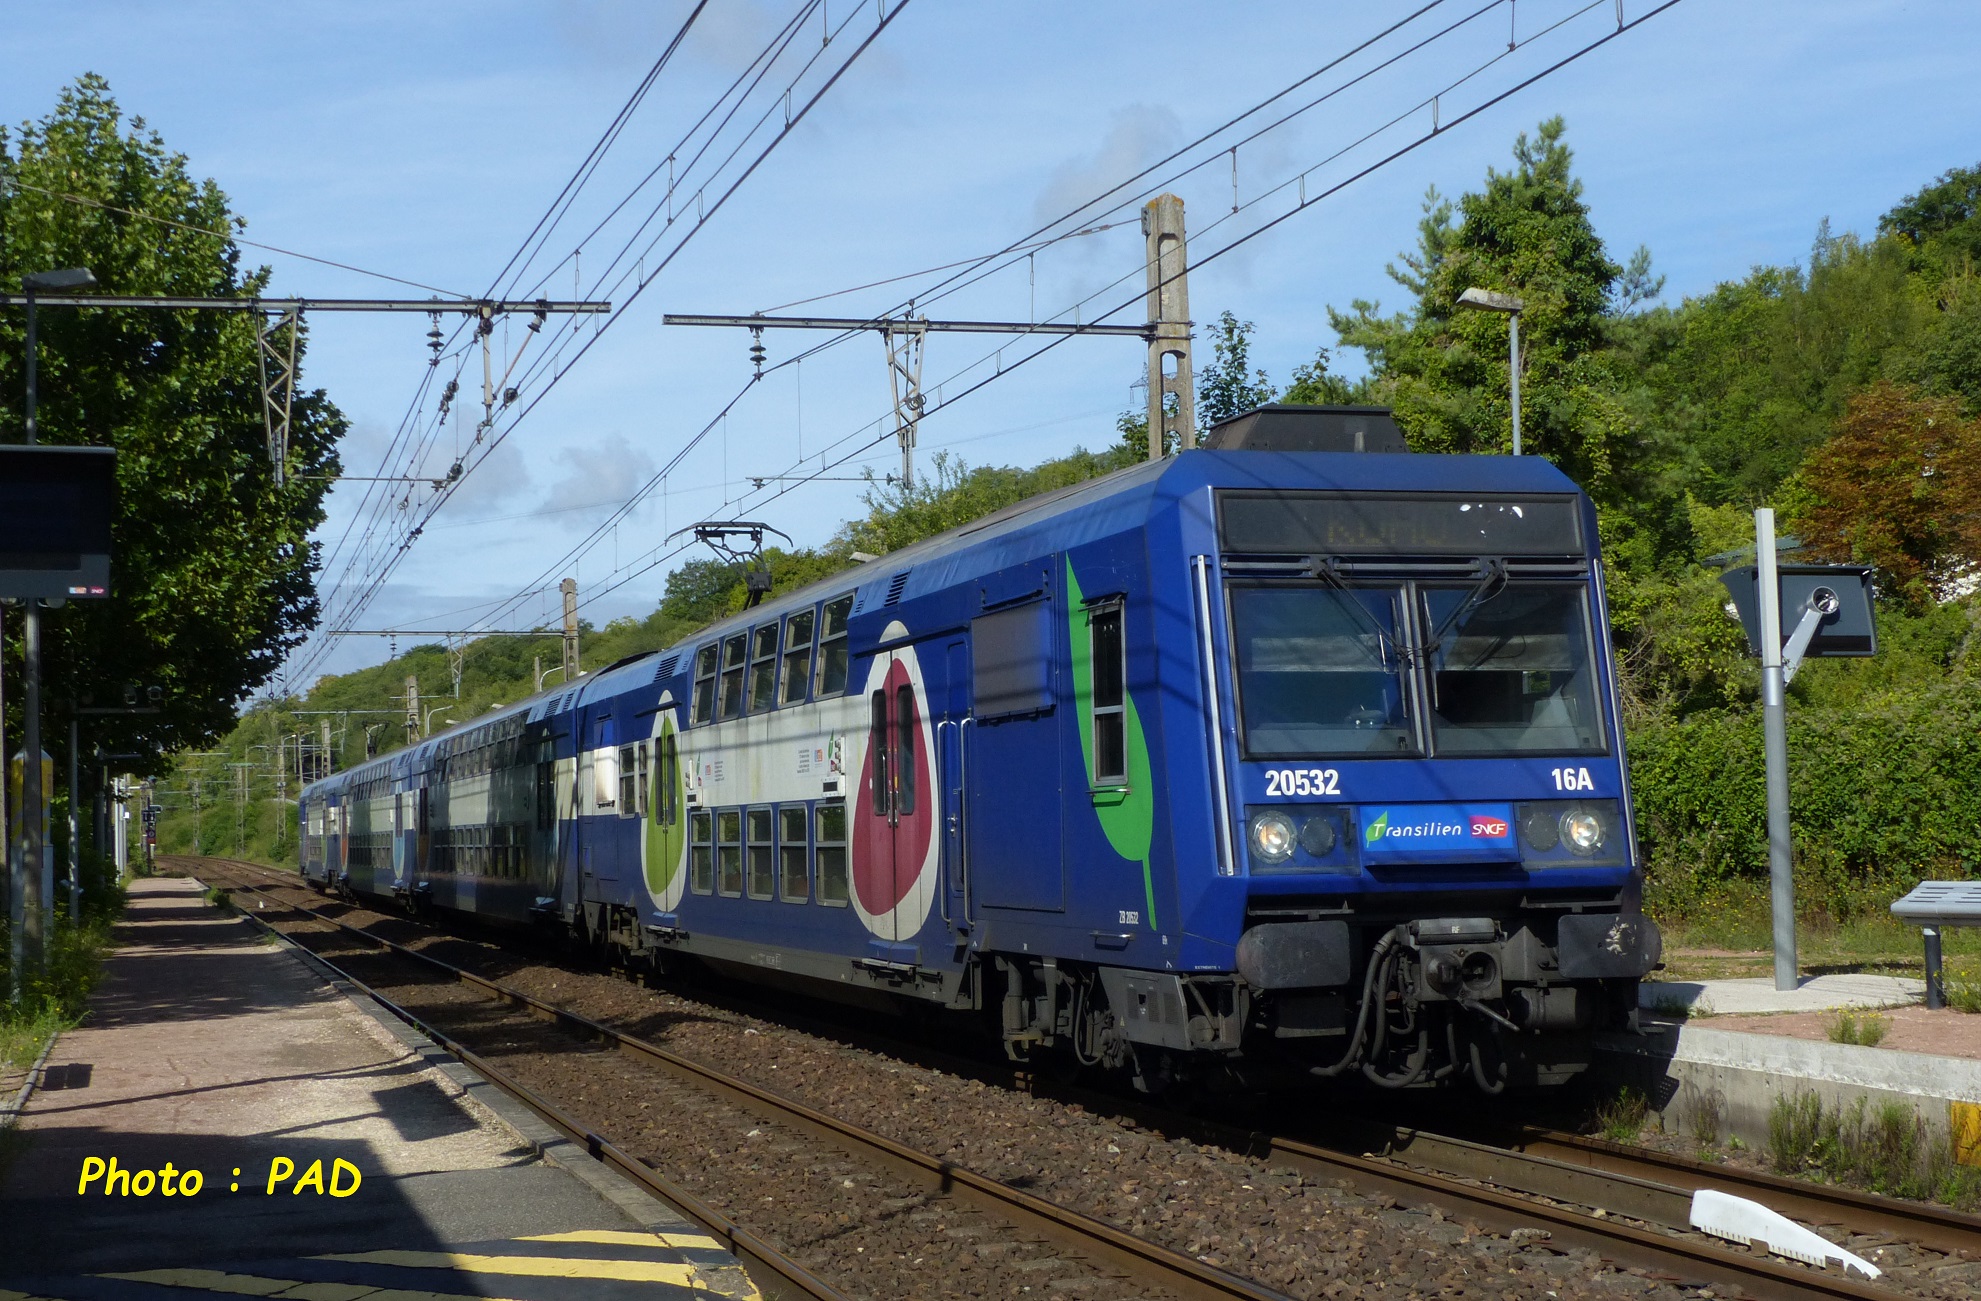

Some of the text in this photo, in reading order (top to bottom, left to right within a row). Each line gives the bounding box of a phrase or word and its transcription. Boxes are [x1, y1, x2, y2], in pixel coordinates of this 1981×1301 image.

[1265, 769, 1341, 796] 20532
[1551, 767, 1594, 791] 16A
[1373, 822, 1462, 838] Transilien
[1471, 823, 1506, 836] SNCF
